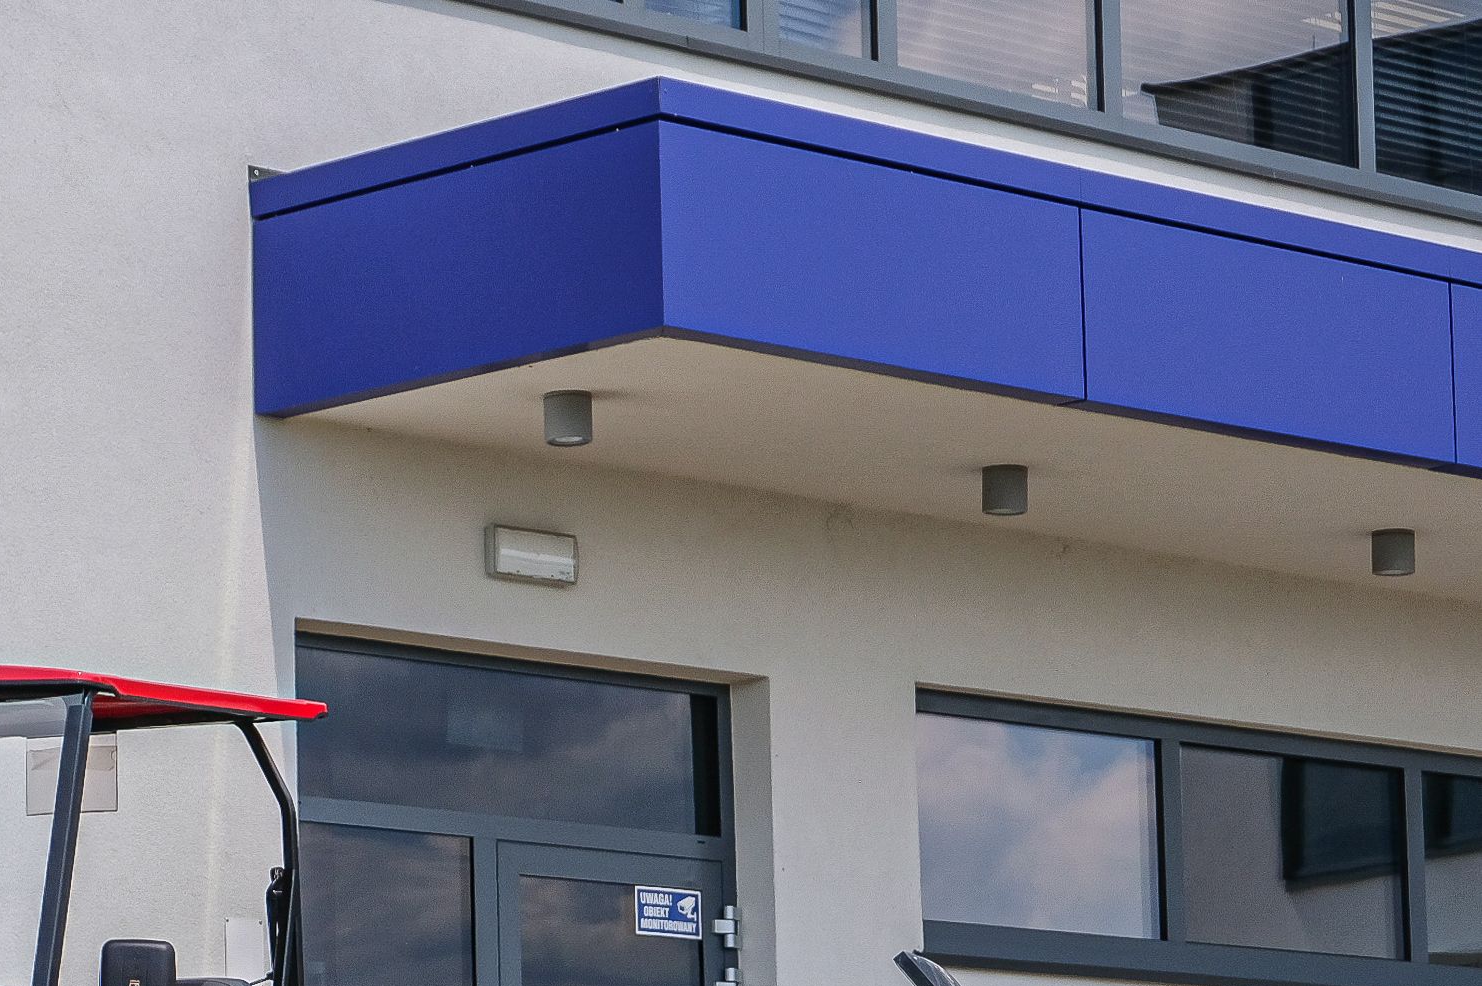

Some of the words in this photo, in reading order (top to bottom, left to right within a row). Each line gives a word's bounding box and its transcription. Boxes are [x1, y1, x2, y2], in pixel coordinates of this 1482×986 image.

[640, 892, 672, 906] UWAGA!
[643, 906, 669, 917] OBIEKT
[640, 918, 696, 933] MONITOROWANY
